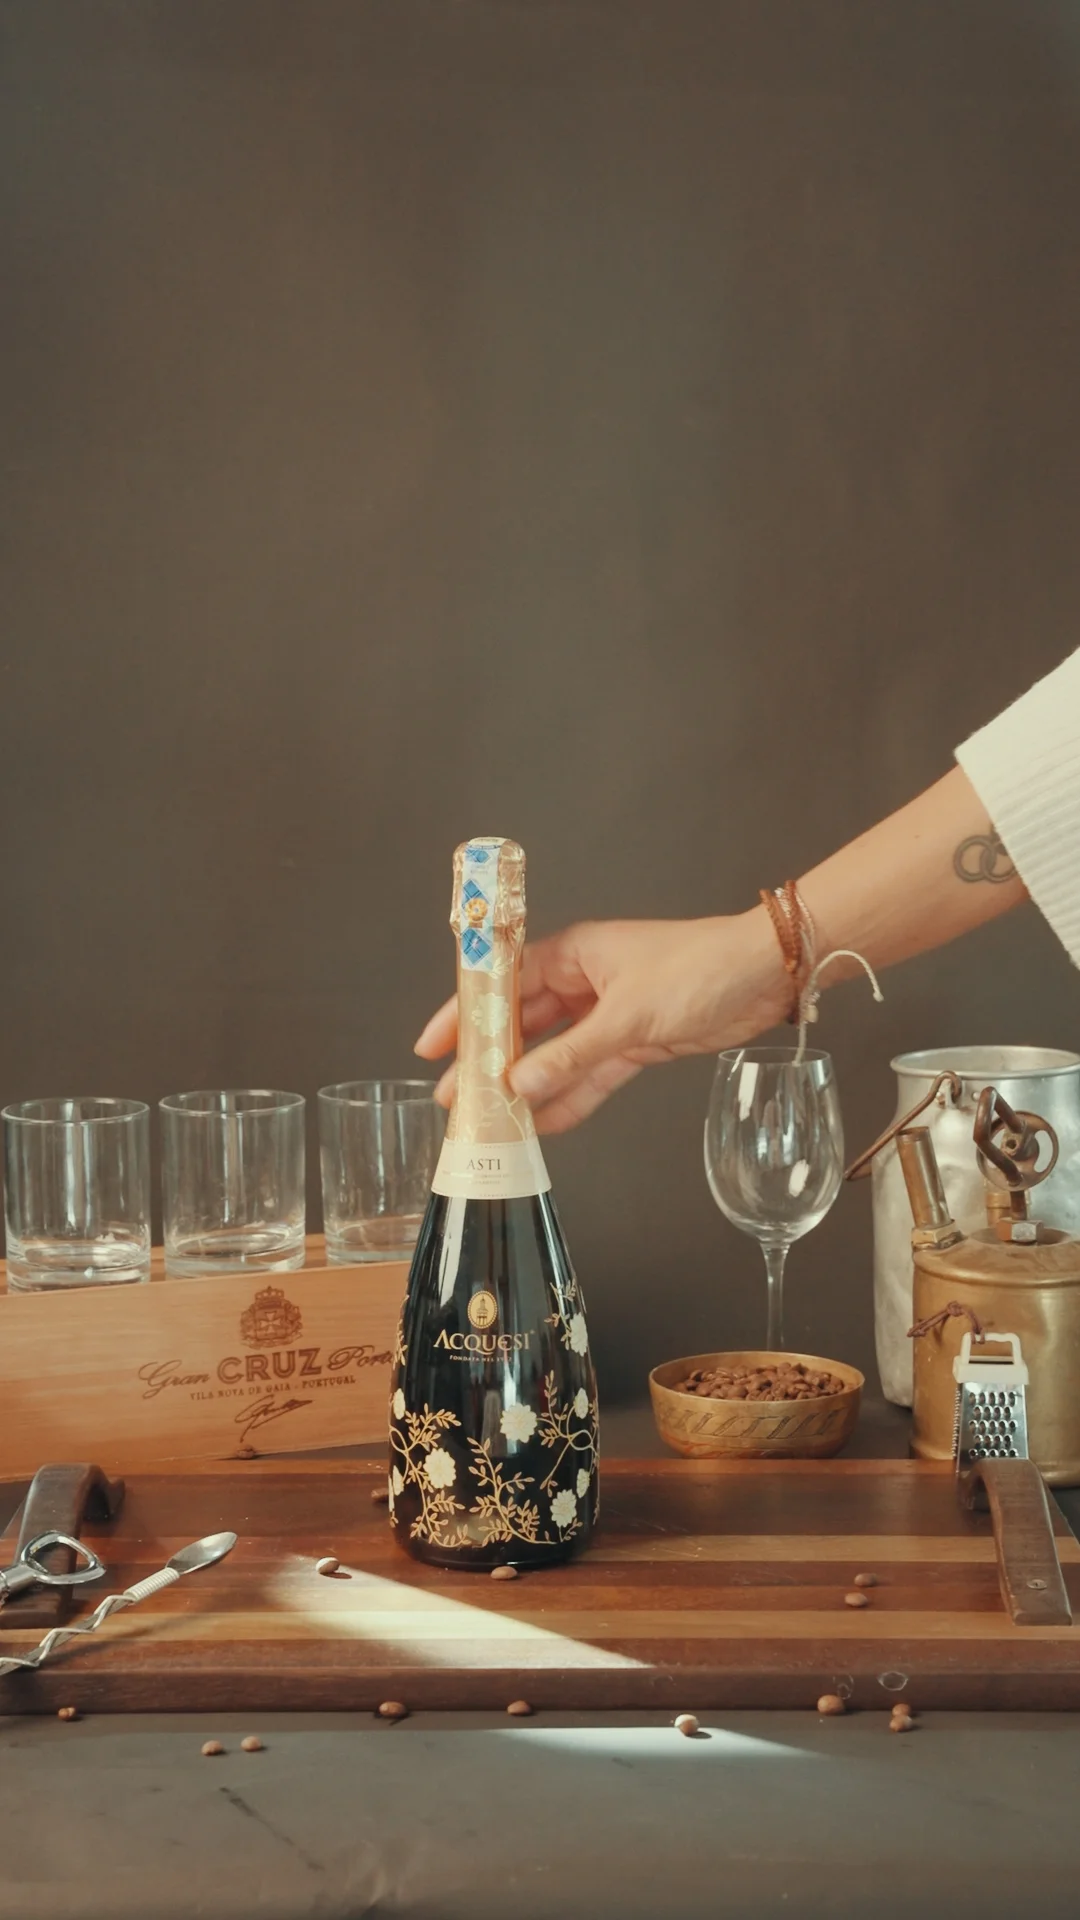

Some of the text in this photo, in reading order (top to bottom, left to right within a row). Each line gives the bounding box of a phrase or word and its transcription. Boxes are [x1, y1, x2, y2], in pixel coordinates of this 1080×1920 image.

[466, 1158, 501, 1171] ASTI
[433, 1328, 531, 1355] ACQUESI
[138, 1359, 210, 1400] Gran
[217, 1347, 322, 1385] CRUZ
[218, 1388, 244, 1398] NOVA
[248, 1385, 261, 1395] DE
[266, 1383, 290, 1393] GAIA
[302, 1375, 356, 1389] PORTUGAL
